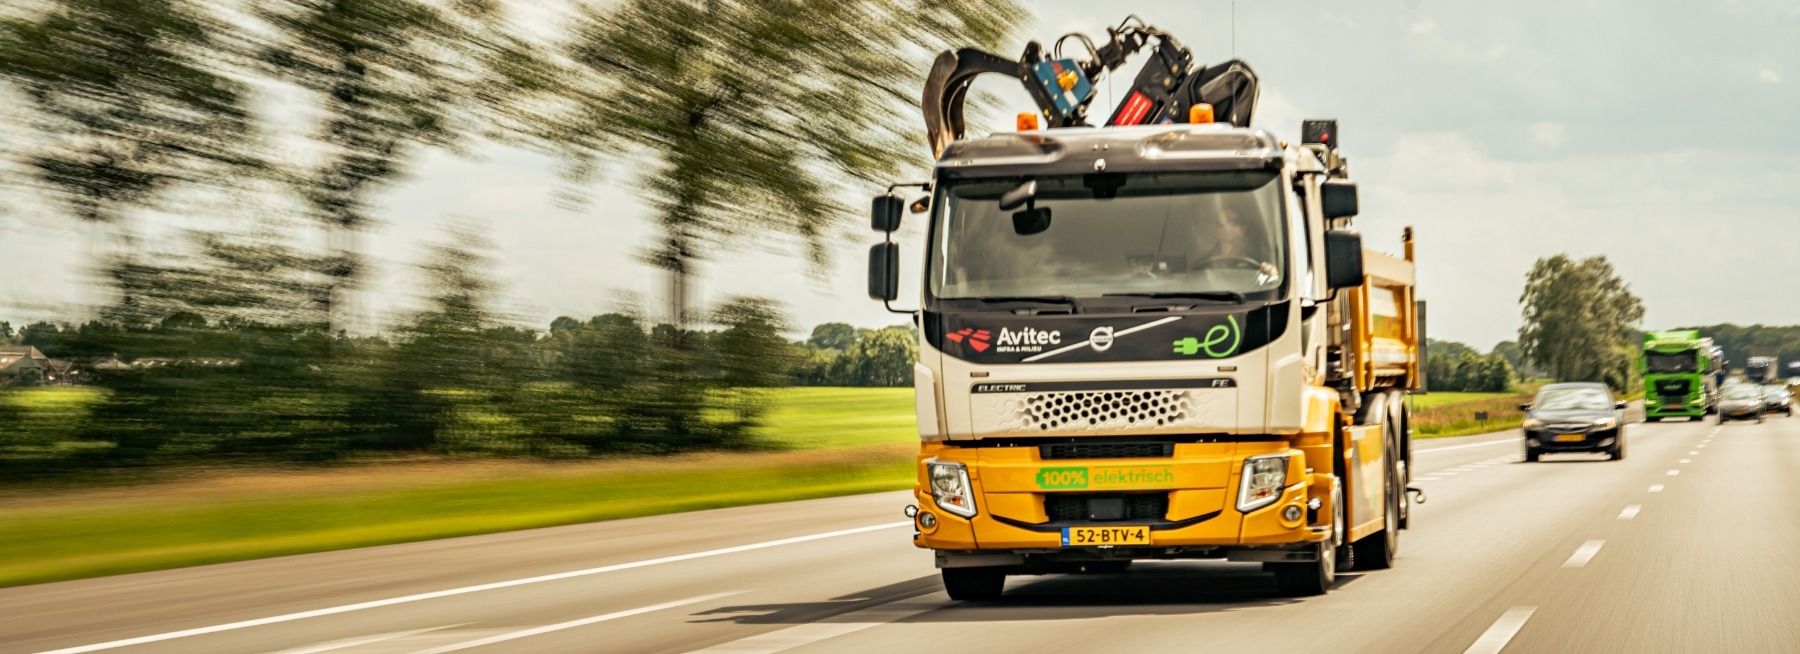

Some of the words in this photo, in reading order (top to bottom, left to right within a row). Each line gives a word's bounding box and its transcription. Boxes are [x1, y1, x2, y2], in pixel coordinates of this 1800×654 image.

[997, 327, 1061, 345] Avitec
[978, 384, 1026, 392] ELECTRIC
[1211, 379, 1229, 388] FE
[1042, 471, 1086, 485] 100%
[1094, 468, 1174, 483] elektrisch
[1077, 529, 1144, 542] 52-BTV-4
